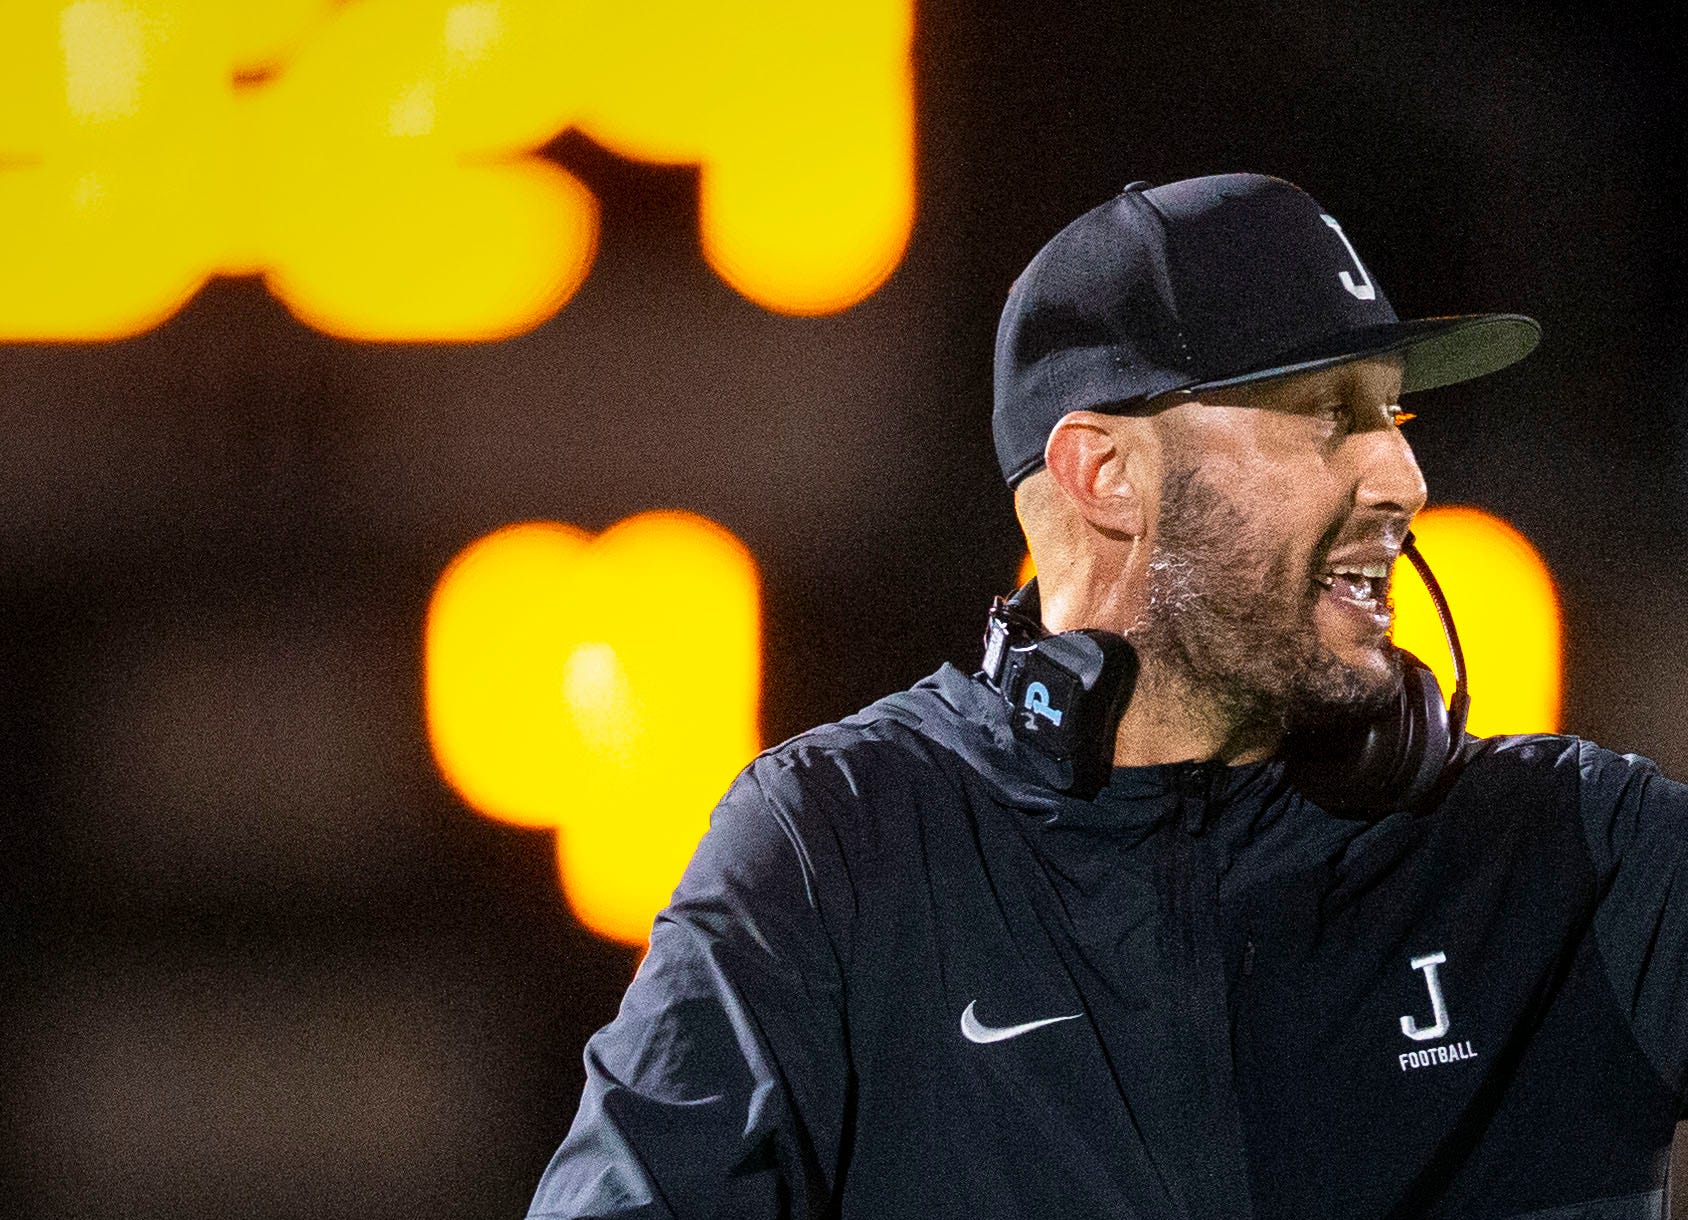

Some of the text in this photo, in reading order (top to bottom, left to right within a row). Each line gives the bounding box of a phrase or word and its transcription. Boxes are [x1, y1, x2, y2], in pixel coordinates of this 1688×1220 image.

[1319, 214, 1376, 300] J
[1024, 681, 1063, 727] P
[1400, 951, 1450, 1040] J
[1398, 1041, 1478, 1071] FOOTBALL
